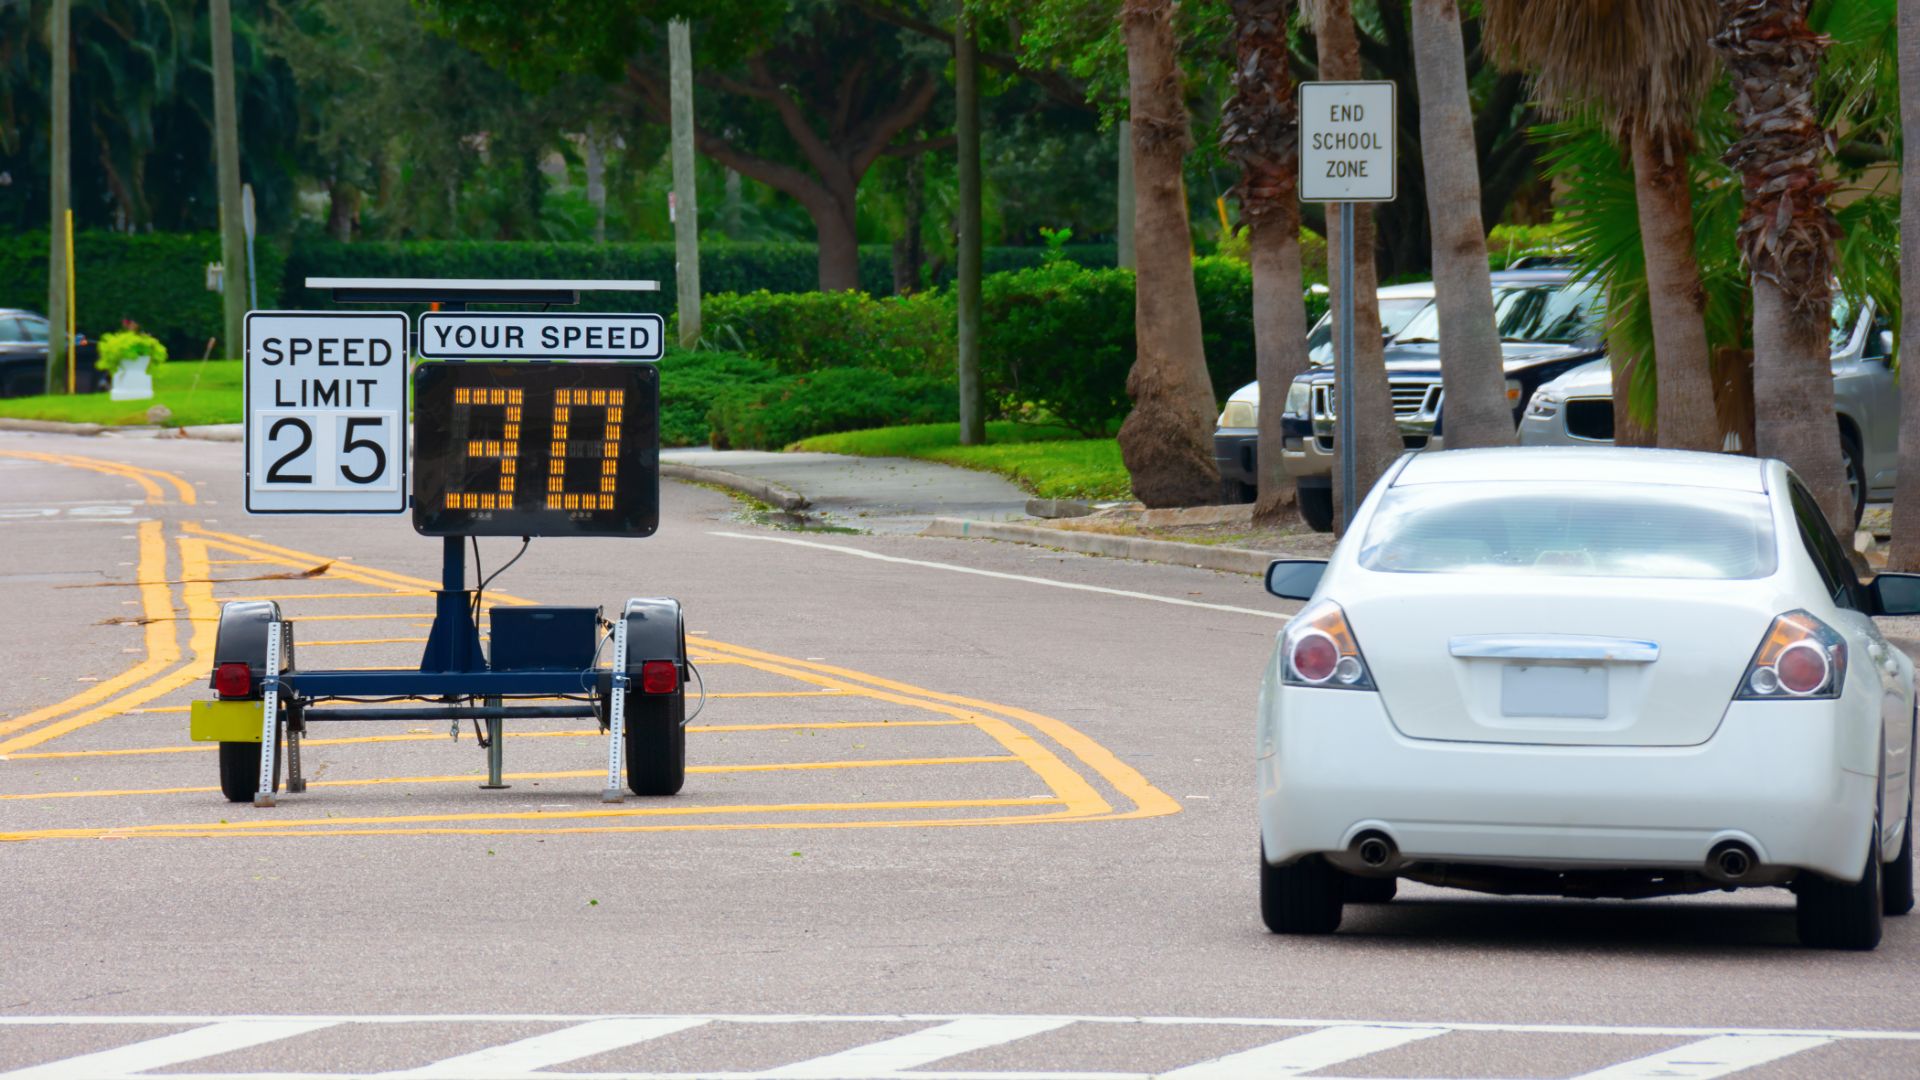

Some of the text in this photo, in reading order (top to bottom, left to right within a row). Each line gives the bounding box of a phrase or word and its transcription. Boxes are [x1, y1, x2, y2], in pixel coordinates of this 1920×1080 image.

[1330, 104, 1364, 122] END
[1312, 132, 1382, 150] SCHOOL
[1326, 160, 1368, 178] ZONE
[434, 325, 650, 350] YOUR SPEED
[262, 338, 392, 366] SPEED
[275, 379, 377, 407] LIMIT
[266, 417, 386, 484] 25
[445, 387, 624, 510] 30
